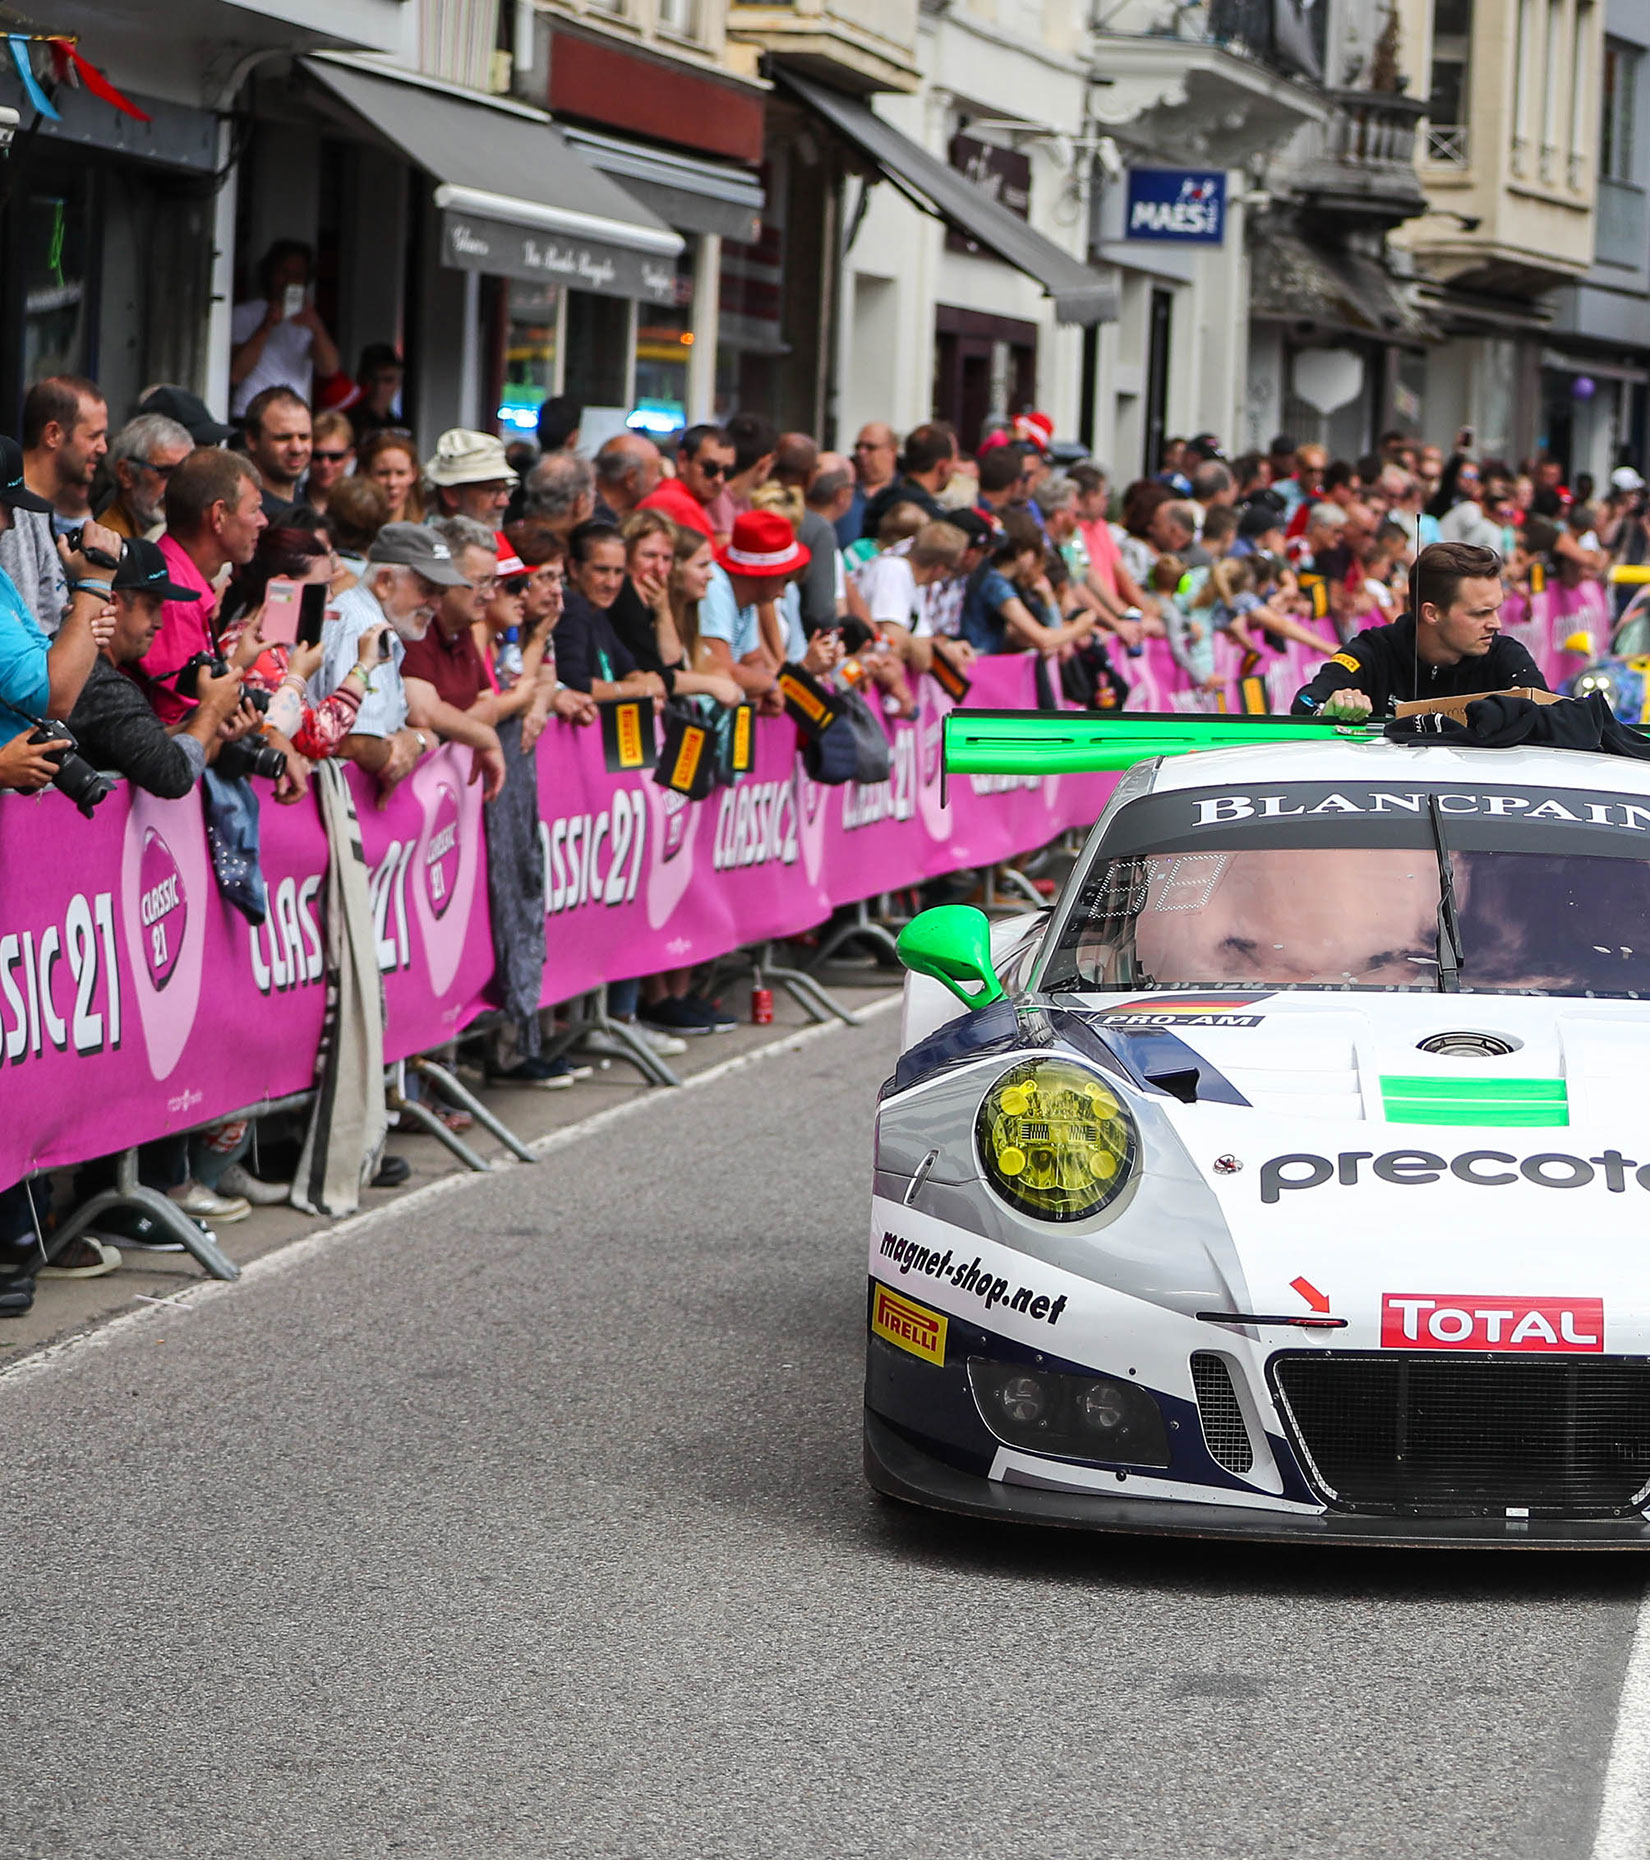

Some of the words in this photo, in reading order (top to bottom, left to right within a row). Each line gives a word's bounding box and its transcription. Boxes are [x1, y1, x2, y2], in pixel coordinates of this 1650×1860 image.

[1131, 201, 1205, 233] MAES
[141, 873, 180, 928] CLASSIC
[151, 922, 169, 968] 21
[1102, 1014, 1255, 1026] PRO-AM
[879, 1231, 1069, 1326] magnet-shop.net
[878, 1293, 940, 1353] PIRELLI
[1388, 1299, 1598, 1345] TOTAL
